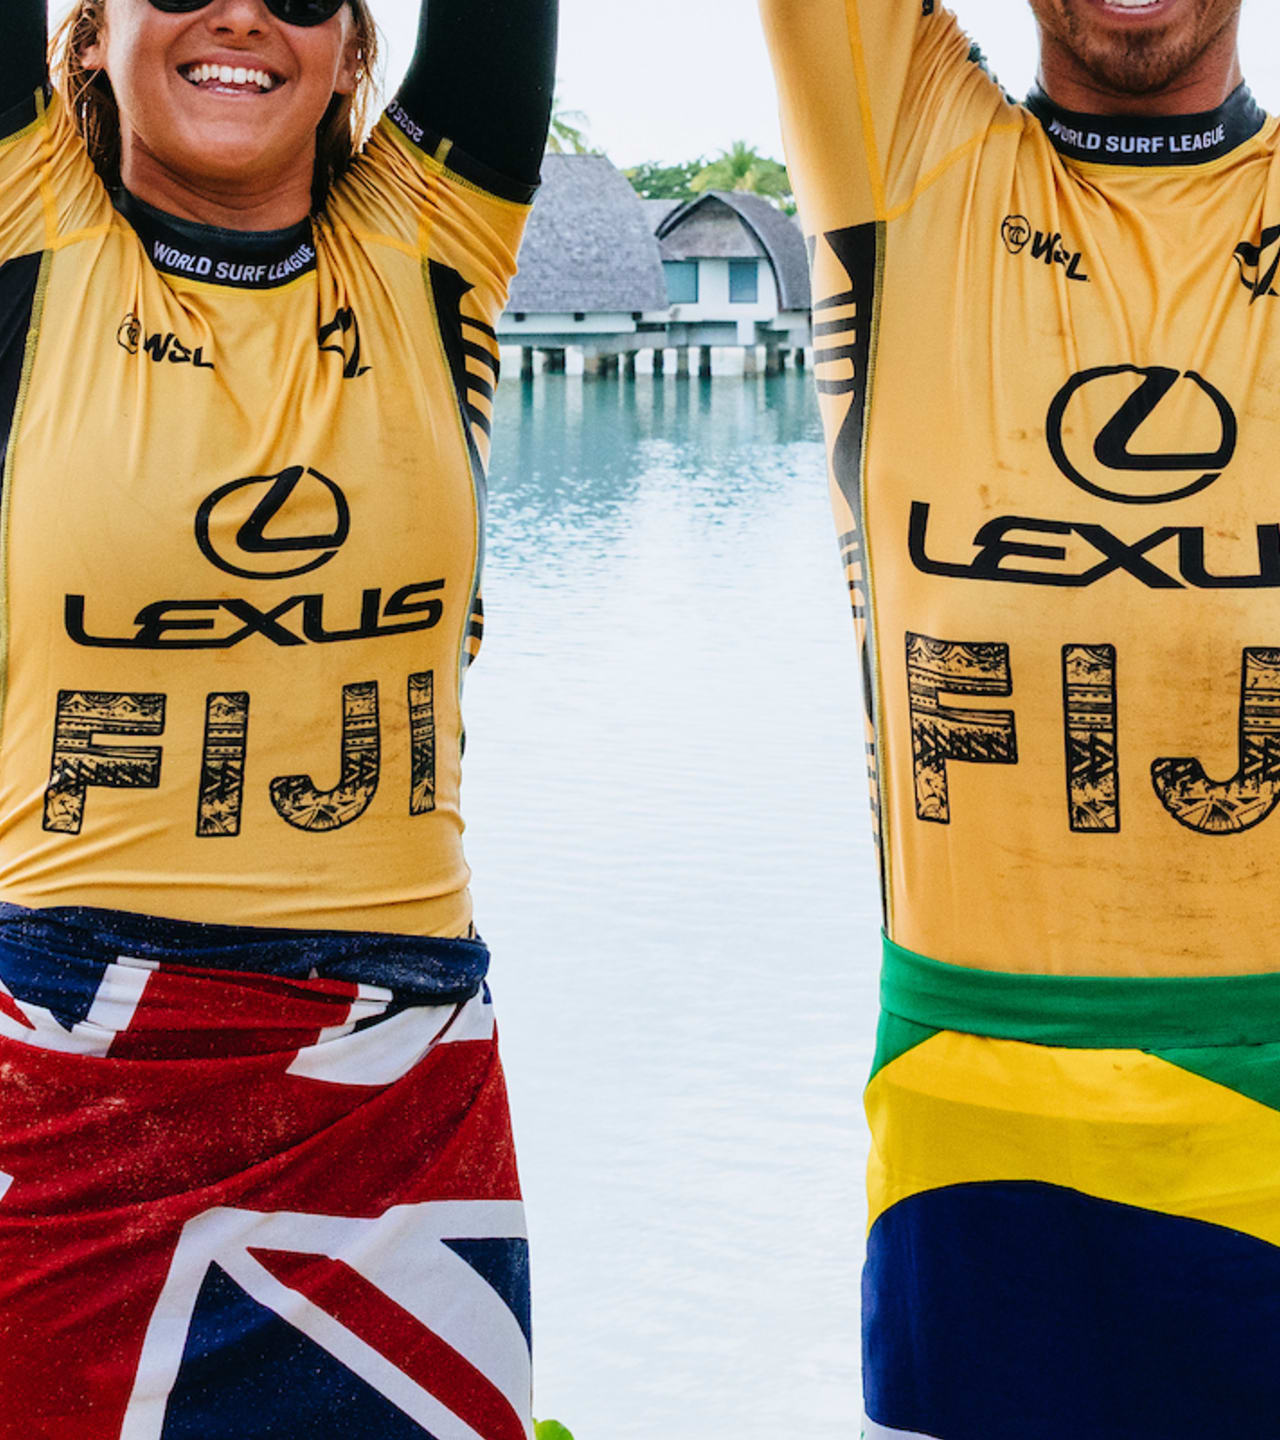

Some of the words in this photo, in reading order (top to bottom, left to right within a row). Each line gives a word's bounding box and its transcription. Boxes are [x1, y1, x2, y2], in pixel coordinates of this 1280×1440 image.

[392, 107, 424, 143] 2025
[1048, 118, 1101, 150] WORLD
[1105, 135, 1165, 153] SURF
[1169, 123, 1225, 152] LEAGUE
[153, 240, 213, 276] WORLD
[215, 261, 266, 283] SURF
[267, 243, 316, 281] LEAGUE
[64, 579, 446, 650] LEXUS
[42, 669, 435, 837] FIJI
